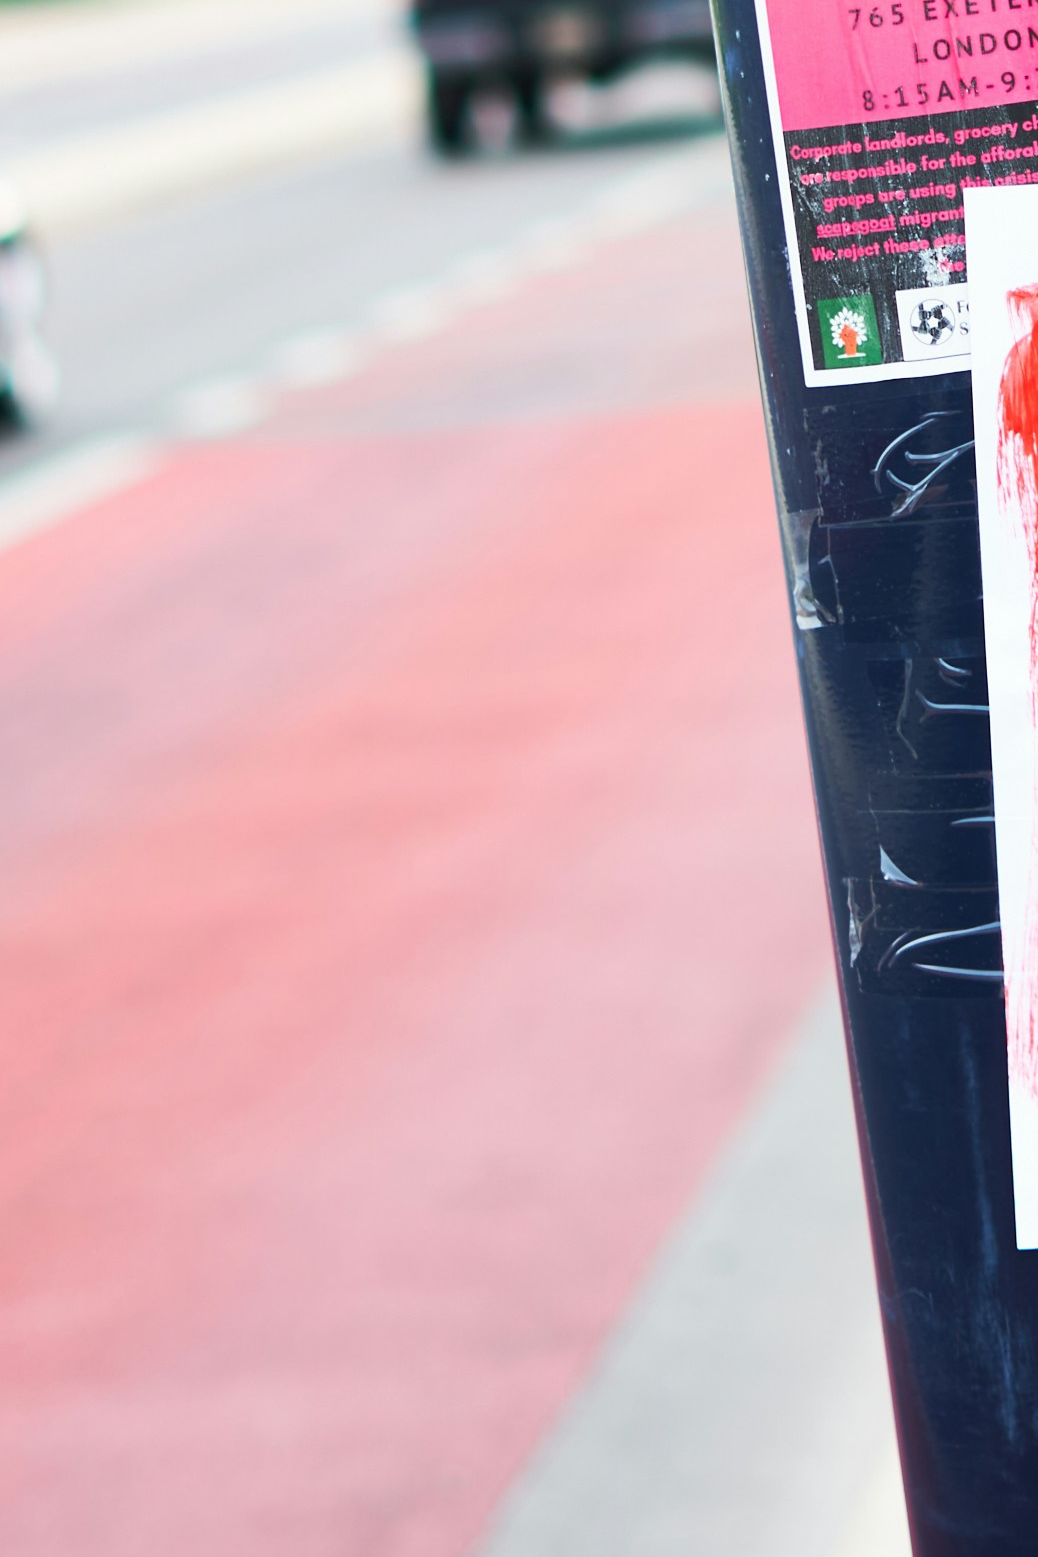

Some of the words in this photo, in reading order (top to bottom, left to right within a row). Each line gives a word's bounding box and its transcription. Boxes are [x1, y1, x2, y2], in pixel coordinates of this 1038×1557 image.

[848, 4, 904, 30] 765
[790, 141, 862, 161] Corporate
[865, 128, 950, 152] landlords,
[954, 122, 1018, 144] grocery
[800, 173, 823, 186] are
[826, 158, 916, 184] responsible
[920, 155, 946, 171] for
[950, 151, 976, 167] the
[823, 192, 874, 213] groups
[878, 189, 905, 203] are
[910, 181, 956, 199] using
[816, 214, 896, 237] scapegoat
[811, 246, 834, 261] We
[838, 242, 880, 262] reject
[884, 238, 929, 255] these
